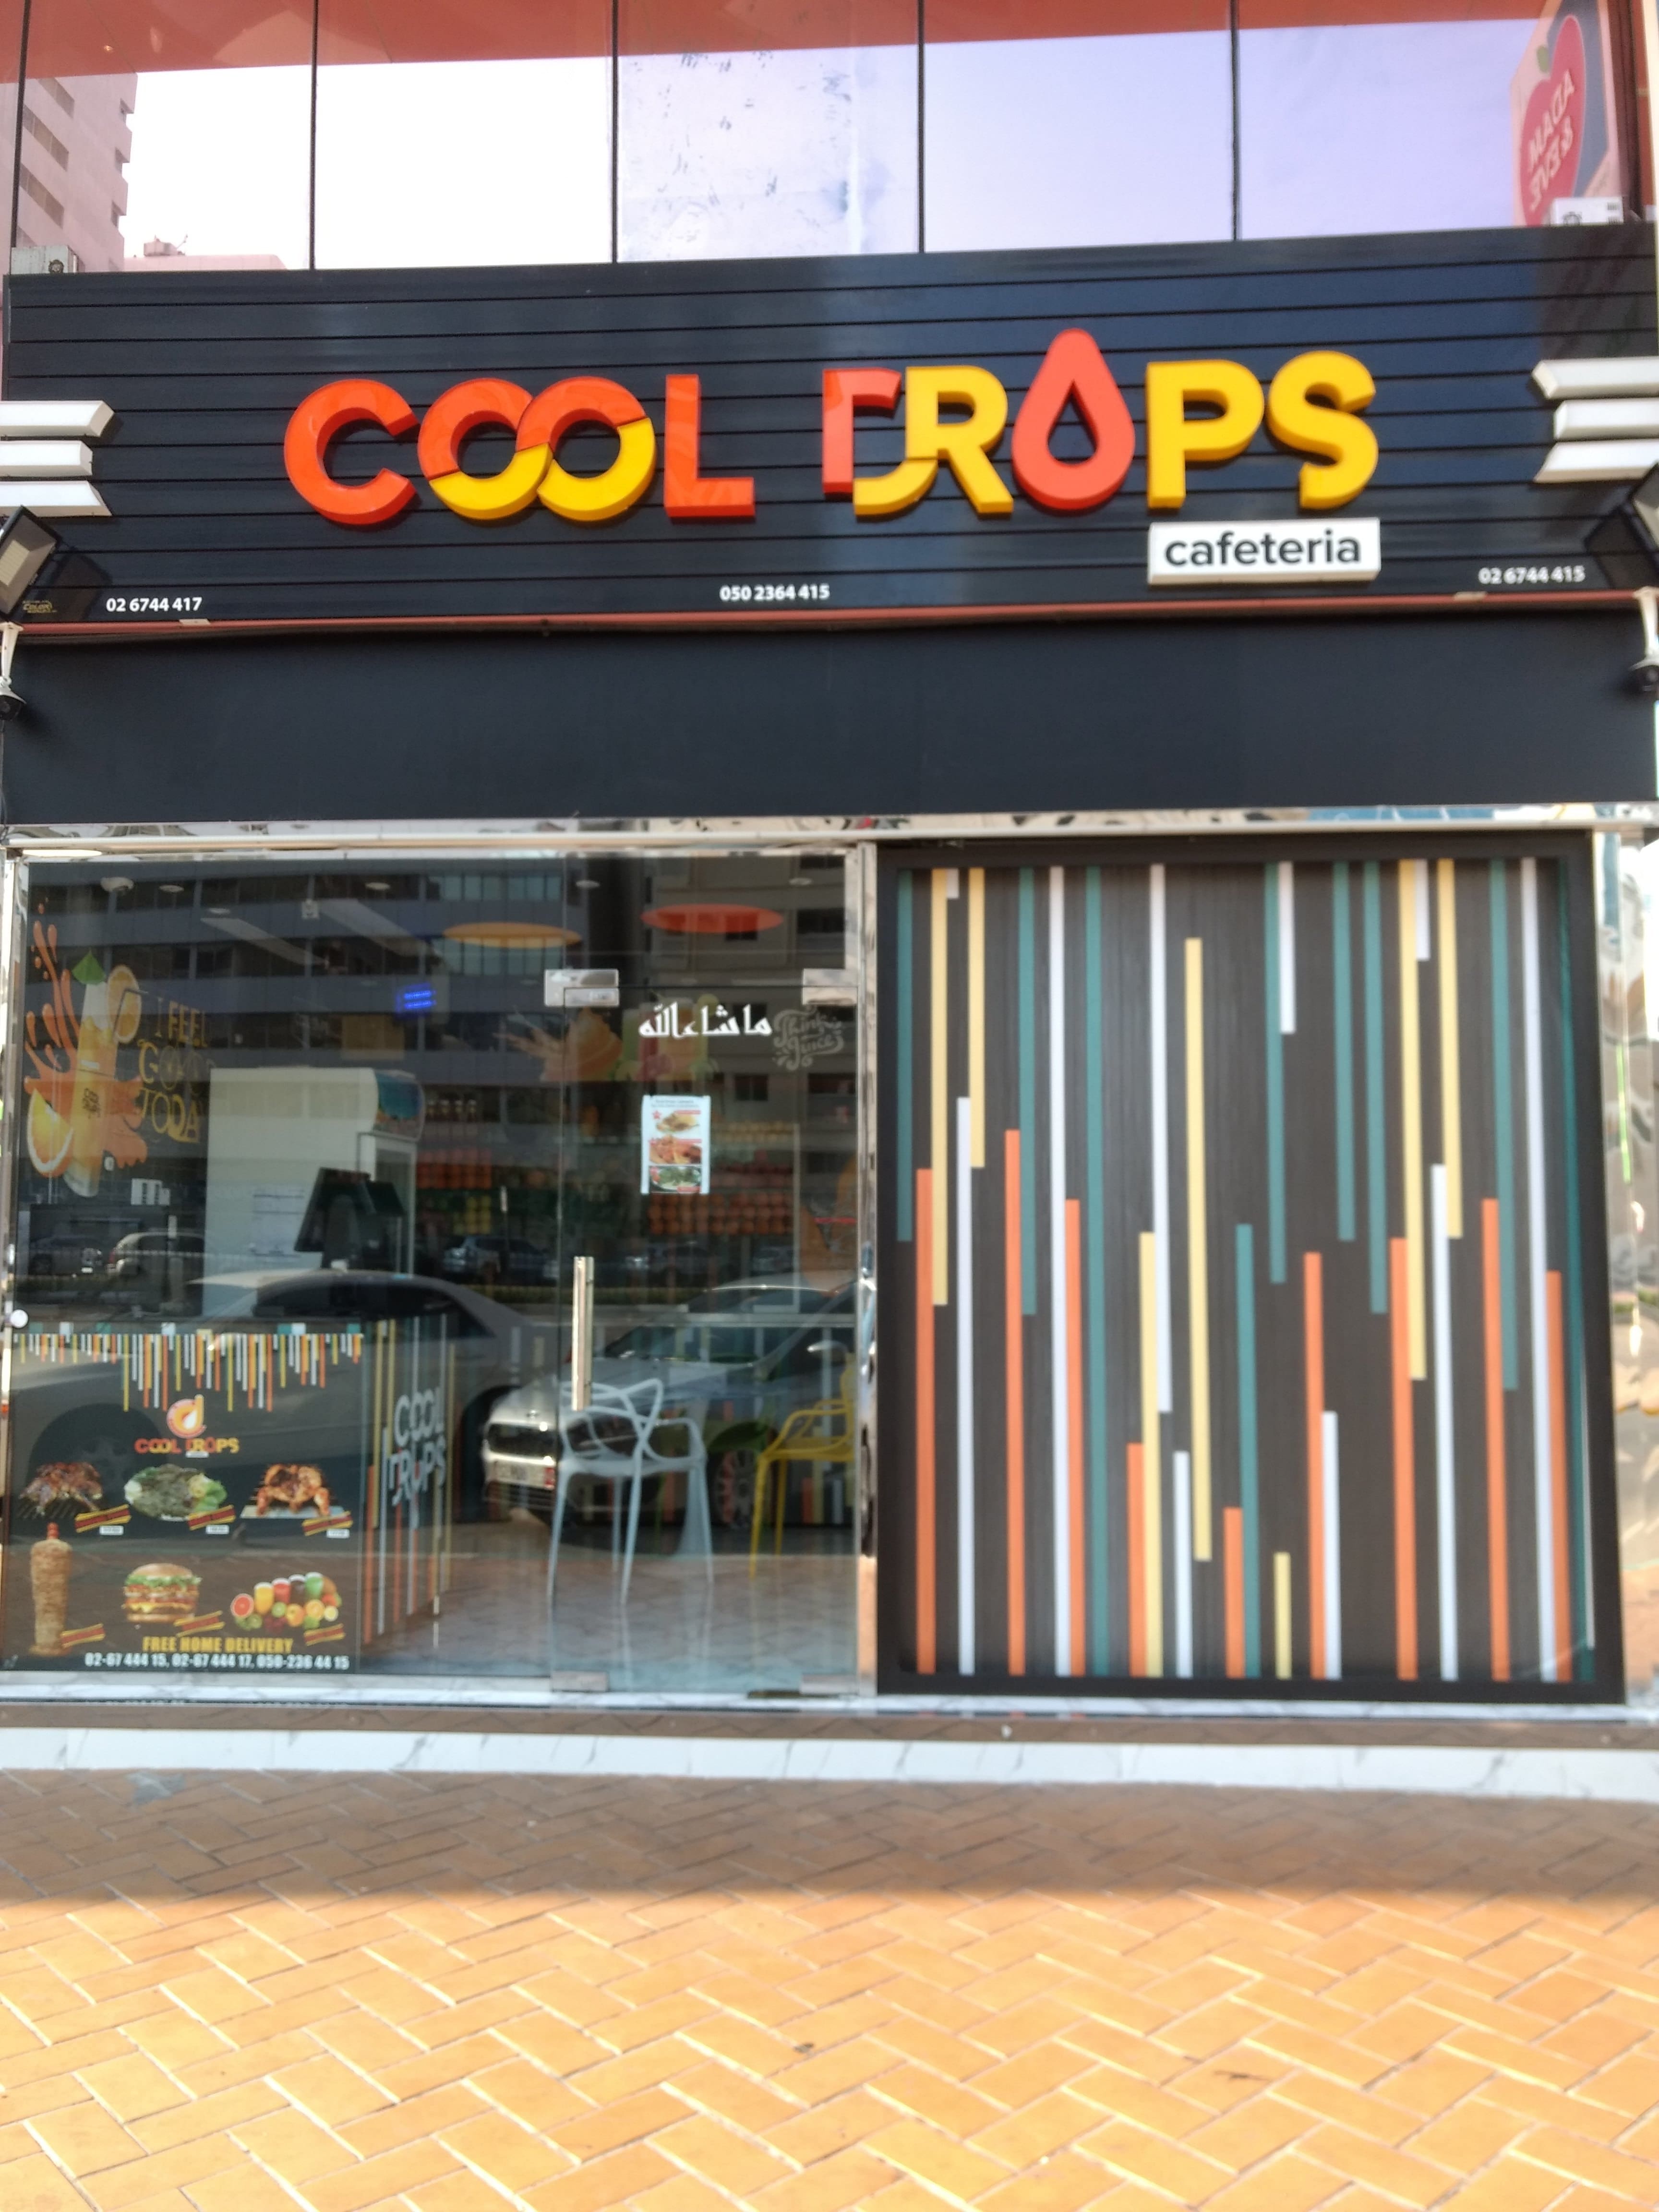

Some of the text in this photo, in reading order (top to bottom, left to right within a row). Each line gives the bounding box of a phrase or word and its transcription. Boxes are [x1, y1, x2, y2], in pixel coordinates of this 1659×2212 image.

[284, 327, 1379, 525] COOL DROPS
[1165, 529, 1361, 566] cafeteria
[1478, 565, 1586, 585] 02 6744 415
[720, 583, 830, 601] 050 2364 415
[106, 597, 203, 612] 02 6744 417
[394, 1386, 445, 1447] COOL
[134, 1438, 182, 1454] COOL
[143, 1636, 293, 1654] FREE HOME DELIVERY
[84, 1652, 122, 1667] 02-67
[123, 1652, 149, 1667] 444
[172, 1653, 209, 1668] 02-67
[210, 1653, 236, 1668] 444
[314, 1655, 332, 1670] 44
[334, 1655, 350, 1670] 15
